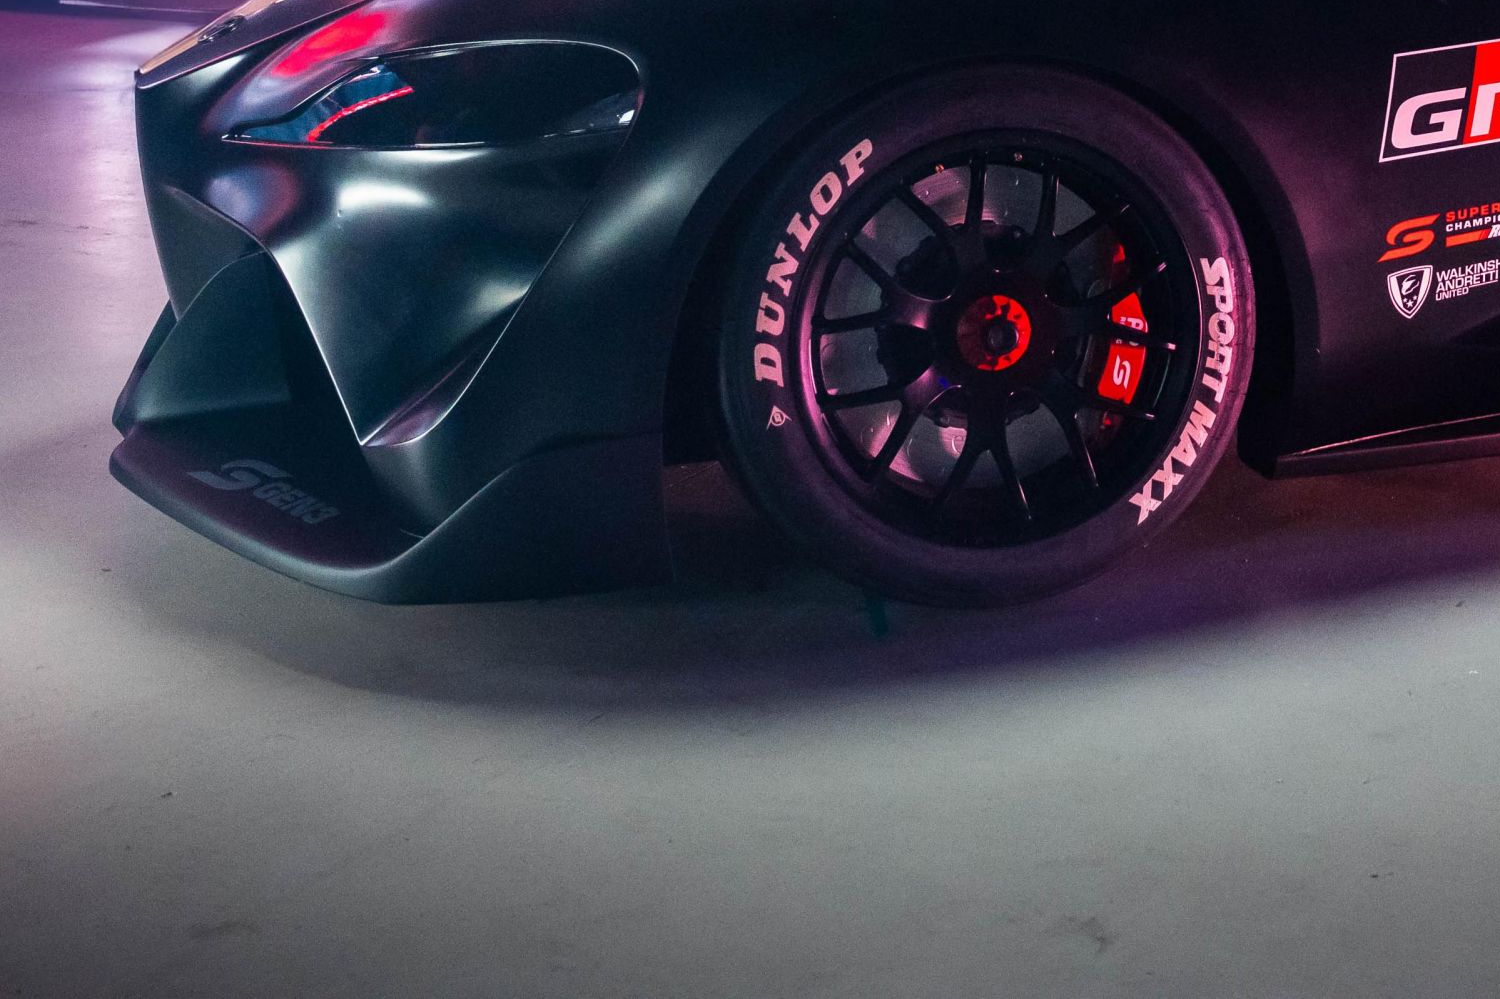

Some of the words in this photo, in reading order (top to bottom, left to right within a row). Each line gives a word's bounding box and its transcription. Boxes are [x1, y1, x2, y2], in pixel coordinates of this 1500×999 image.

[754, 138, 874, 388] DUNLOP
[1435, 270, 1499, 294] ANDRETTI
[1435, 286, 1470, 301] UNITED
[1200, 256, 1236, 404] SPORT
[1129, 399, 1217, 526] MAXX
